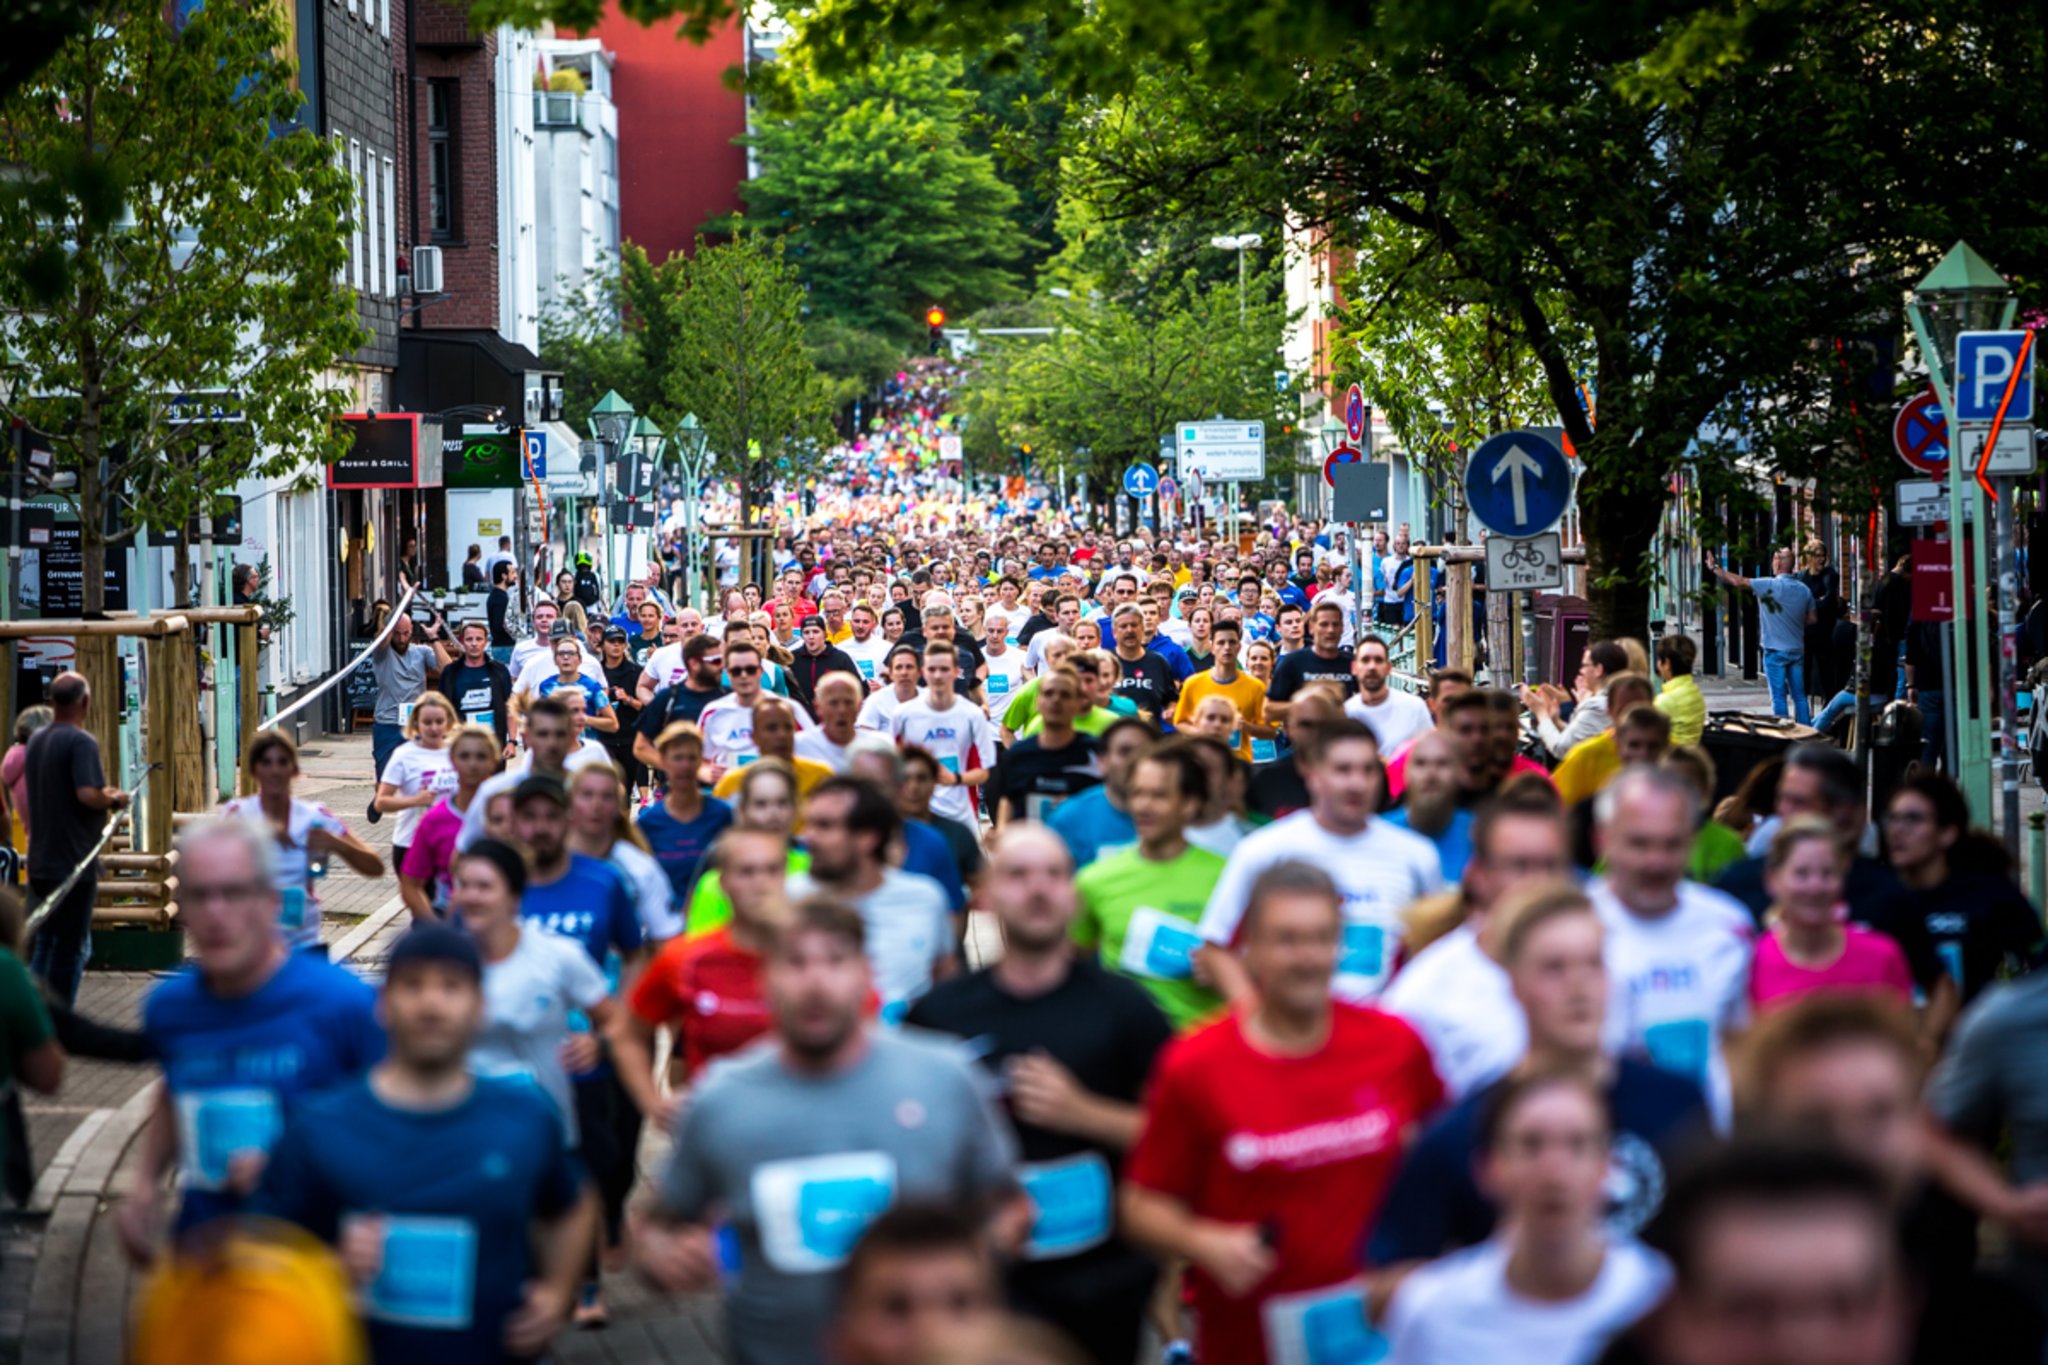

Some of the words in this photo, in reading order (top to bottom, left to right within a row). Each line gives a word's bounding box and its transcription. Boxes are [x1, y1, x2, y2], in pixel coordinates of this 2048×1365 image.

[1974, 346, 2014, 408] P
[380, 459, 409, 467] GRILL
[1513, 570, 1537, 583] frei
